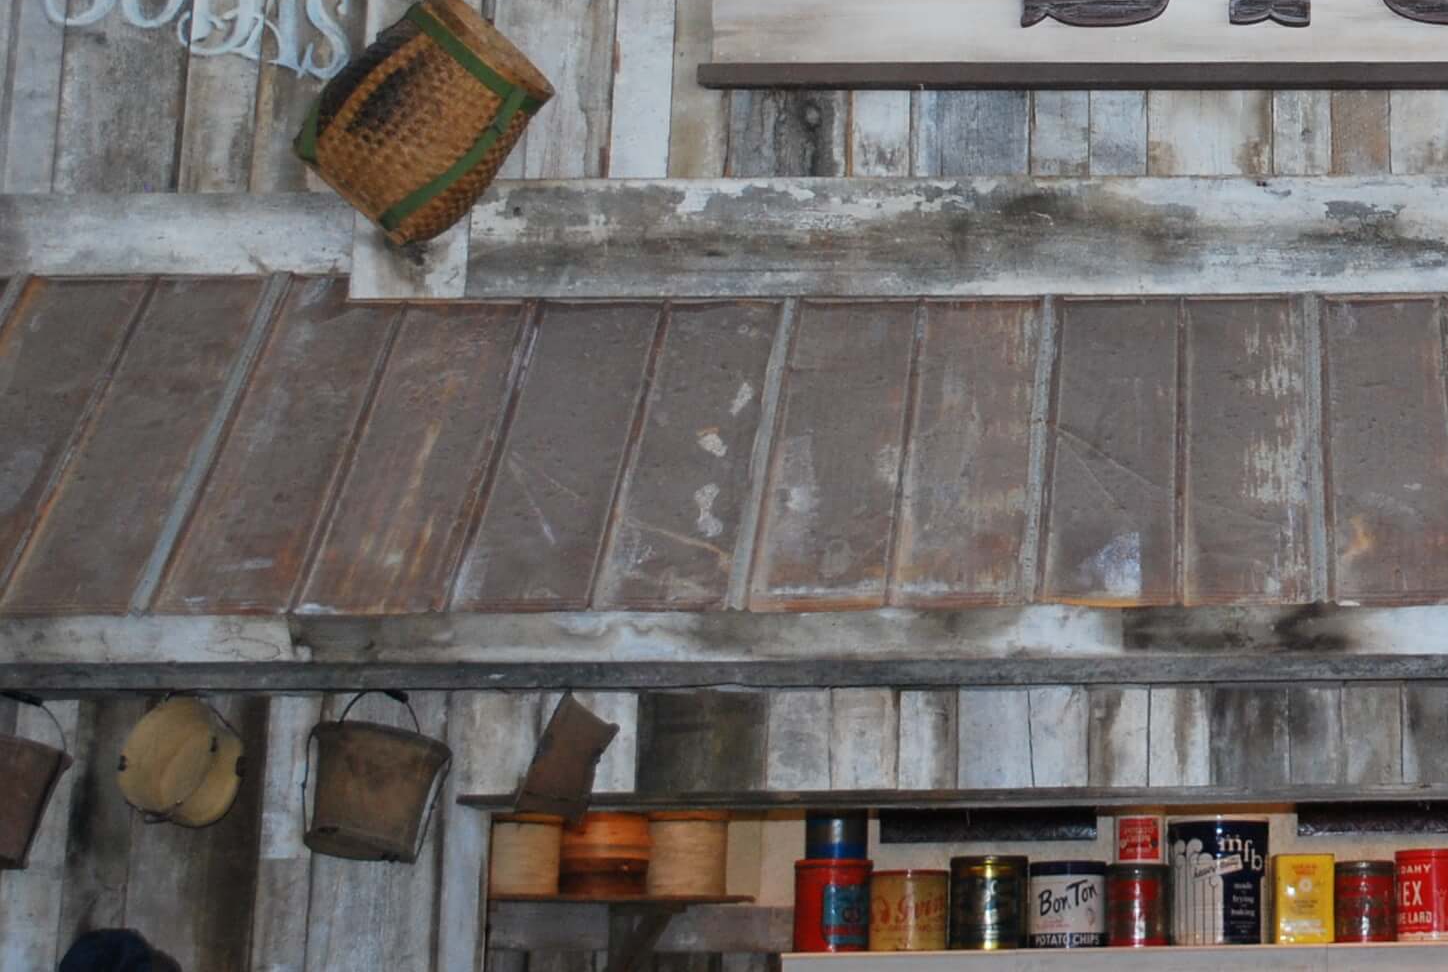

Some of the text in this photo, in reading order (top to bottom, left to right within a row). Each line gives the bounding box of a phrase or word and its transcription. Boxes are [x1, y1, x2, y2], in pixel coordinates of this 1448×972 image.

[1038, 879, 1098, 917] Bon Ton
[1035, 932, 1100, 946] POTATO CHIPS
